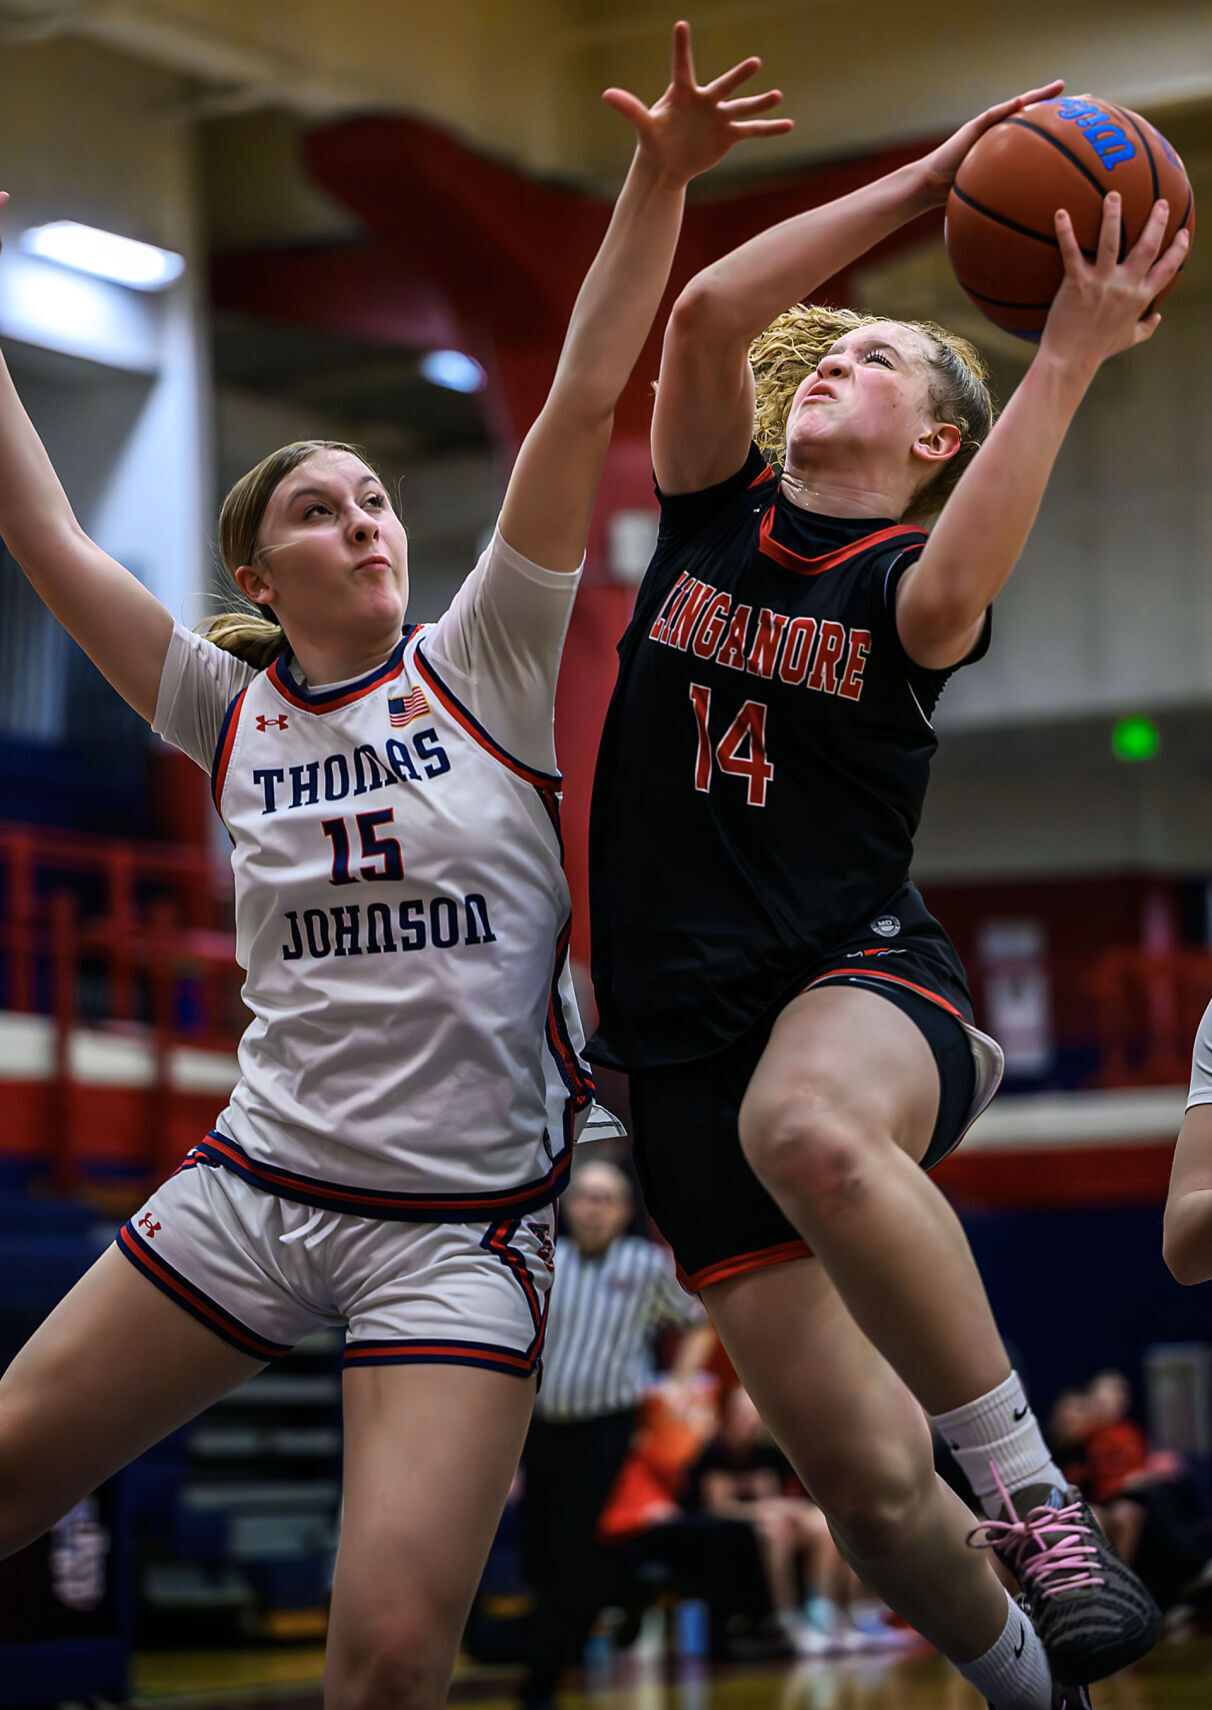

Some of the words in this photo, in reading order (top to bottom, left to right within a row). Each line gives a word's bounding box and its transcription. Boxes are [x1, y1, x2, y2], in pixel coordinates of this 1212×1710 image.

[1043, 97, 1136, 172] Wil
[648, 570, 872, 702] LINGANORE
[253, 727, 452, 815] THOMAS
[689, 682, 774, 808] 14
[321, 807, 405, 886] 15
[282, 893, 497, 961] JOHNSON
